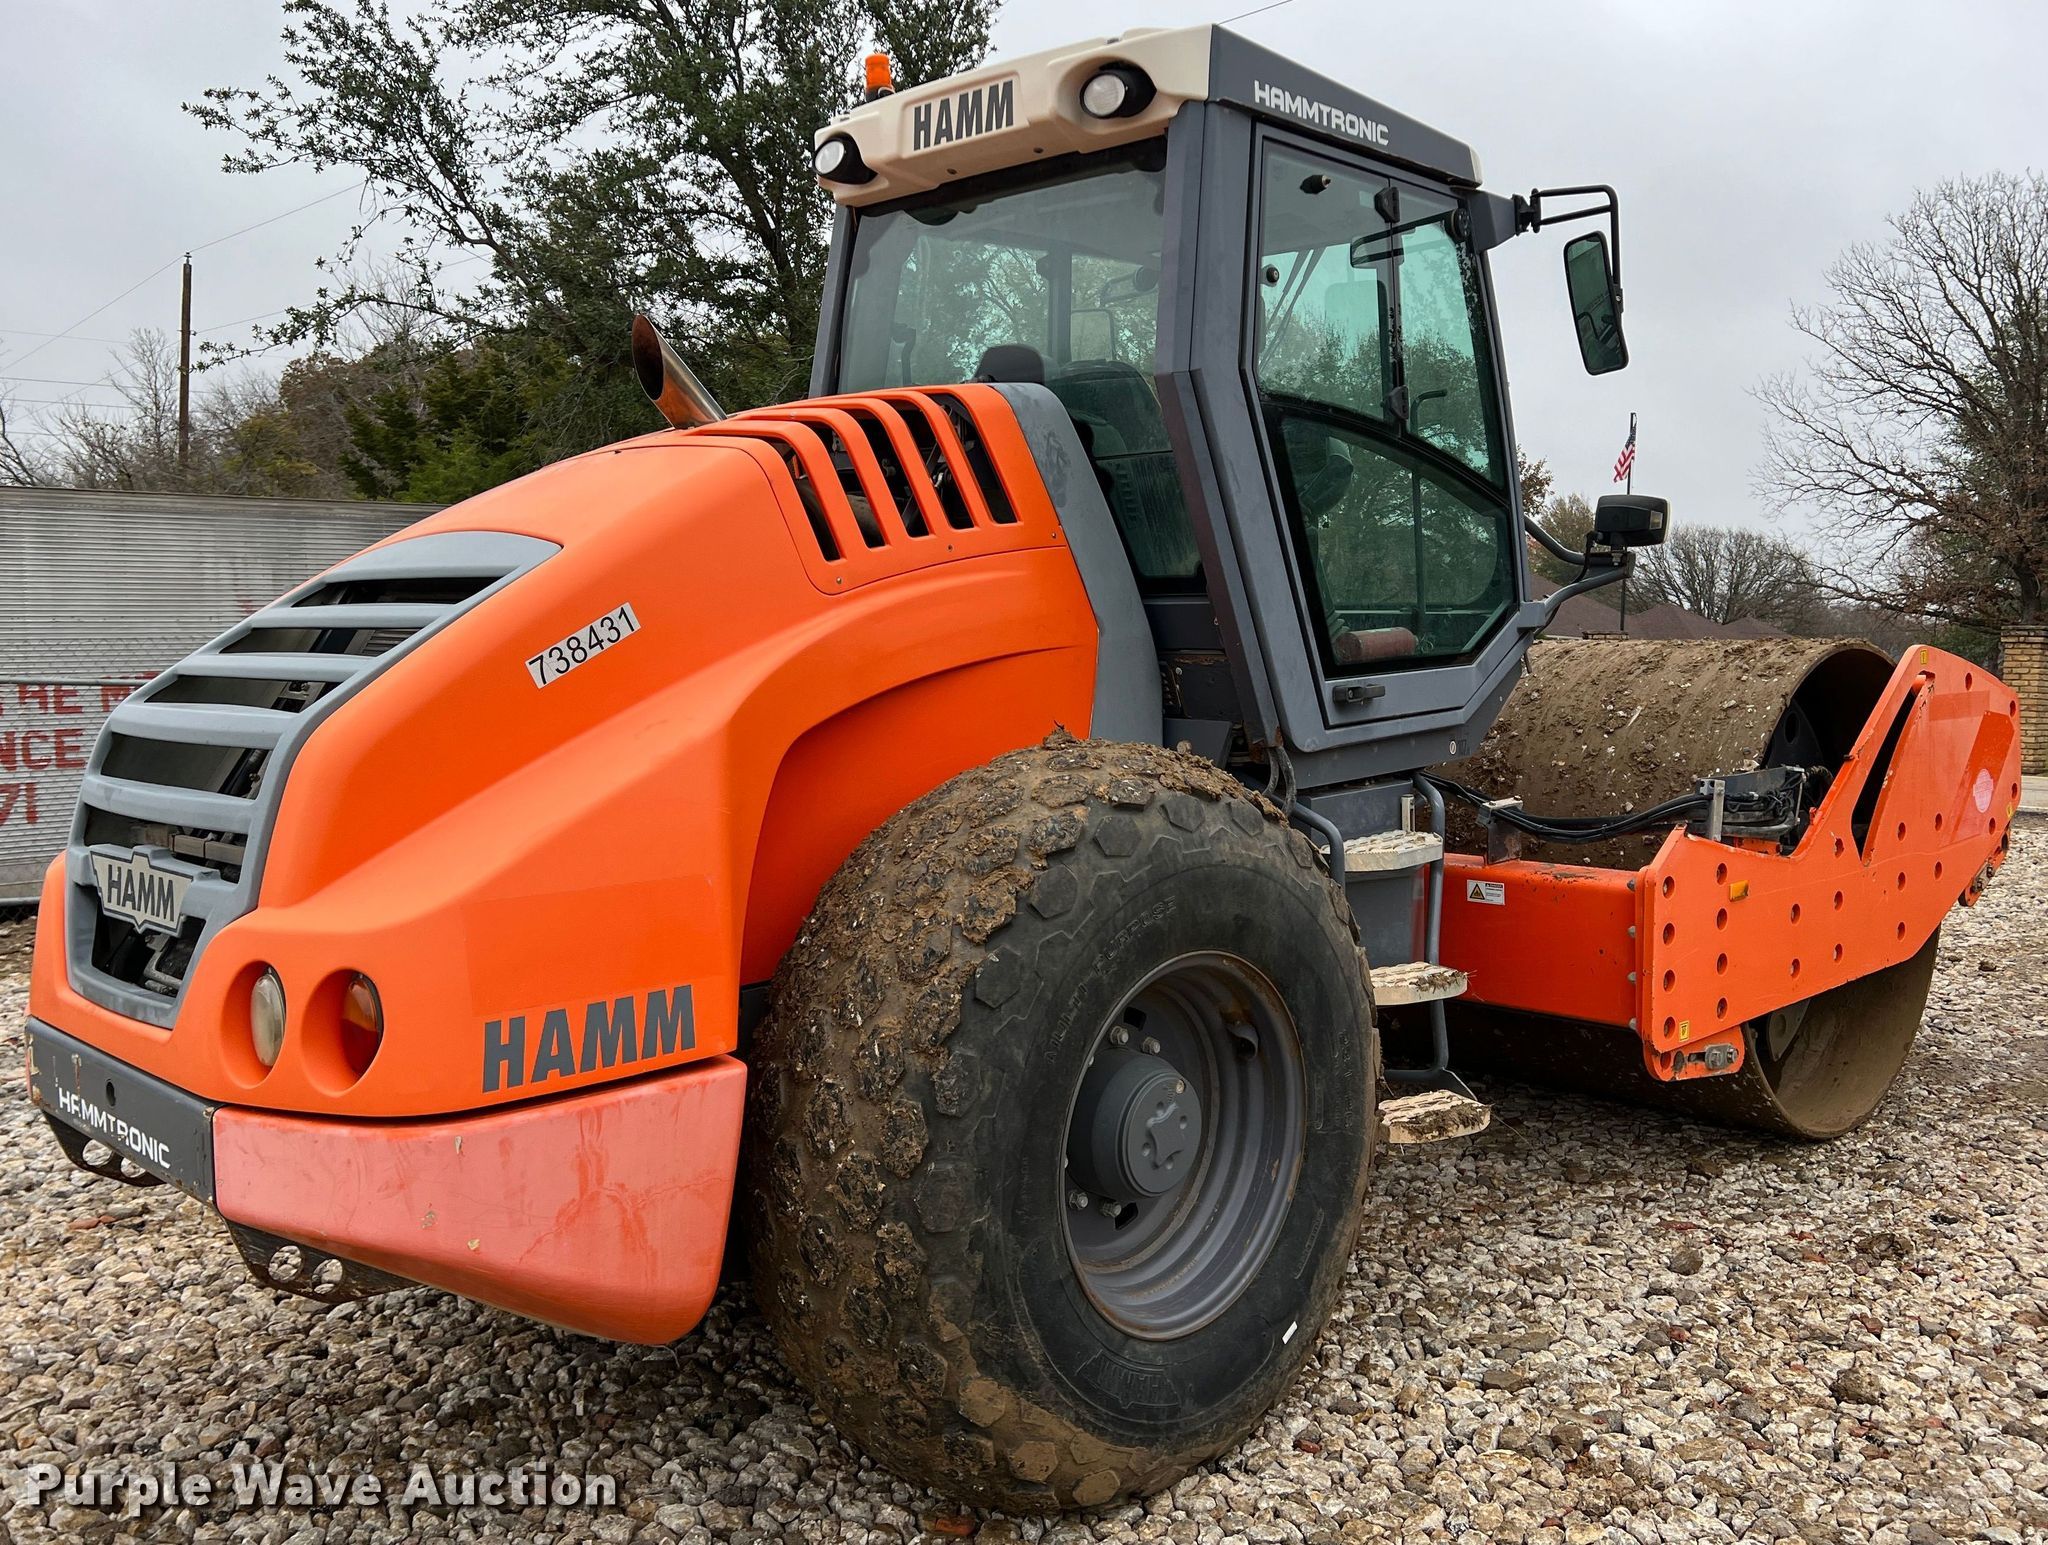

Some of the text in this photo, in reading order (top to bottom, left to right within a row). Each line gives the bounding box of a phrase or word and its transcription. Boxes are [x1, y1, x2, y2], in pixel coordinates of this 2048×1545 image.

[912, 80, 1014, 151] HAMM
[1254, 80, 1389, 147] HAMMTRONIC
[528, 606, 636, 686] 738431
[106, 863, 175, 922] HAMM
[482, 984, 696, 1093] HAMM
[58, 1086, 172, 1169] HAMMTRONIC
